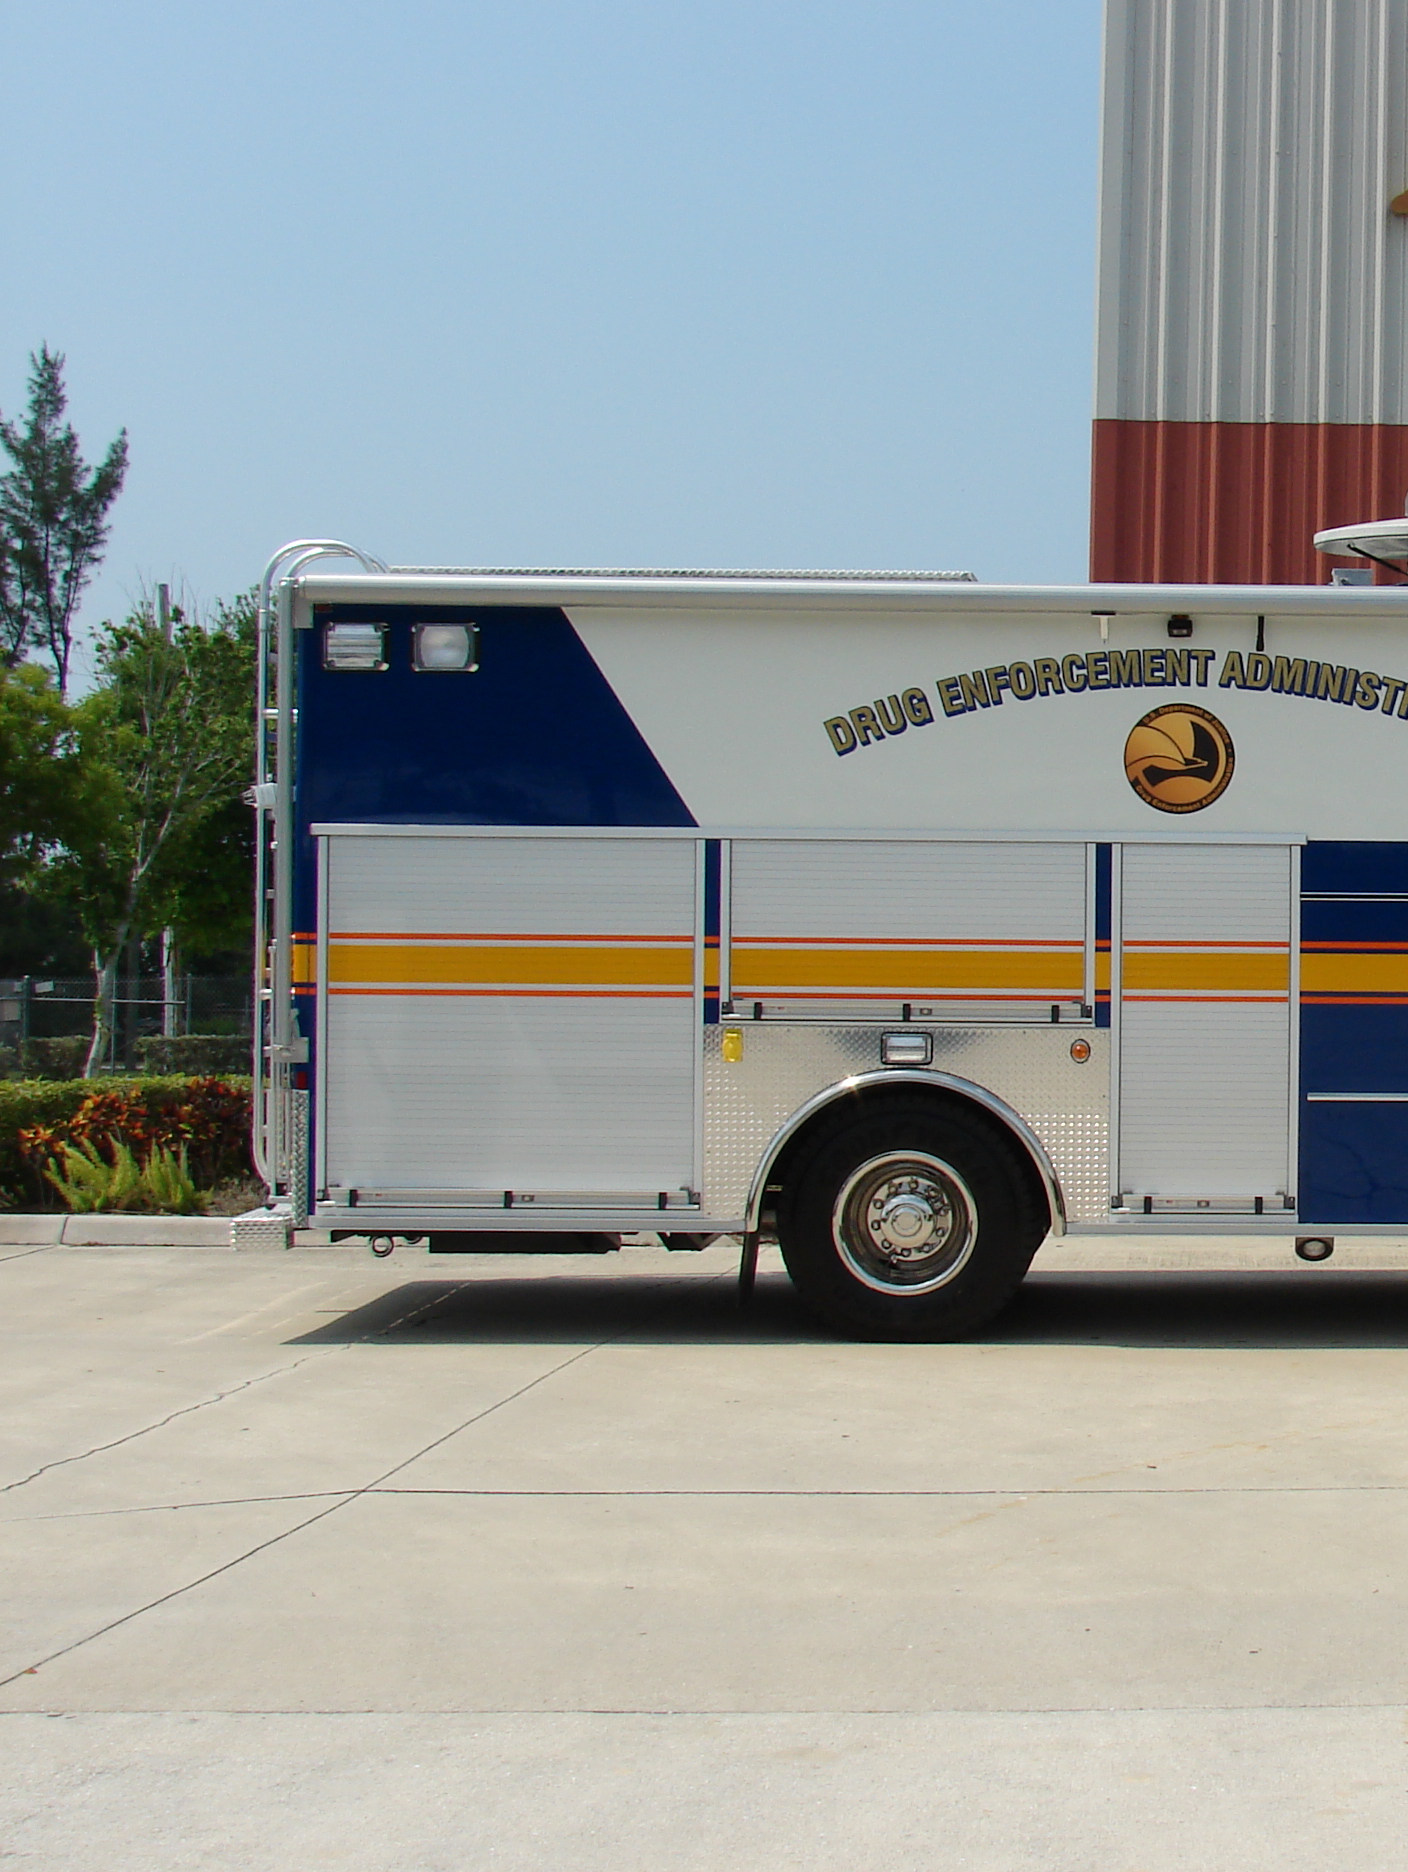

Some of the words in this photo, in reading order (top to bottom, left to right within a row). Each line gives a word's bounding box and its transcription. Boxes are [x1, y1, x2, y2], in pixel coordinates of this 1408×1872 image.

[823, 687, 935, 757] DRUG
[936, 648, 1217, 718] ENFORCEMENT
[1158, 704, 1204, 716] Department
[1203, 711, 1214, 720] of
[1211, 719, 1231, 744] Justice
[1136, 784, 1152, 803] Drug
[1151, 799, 1201, 813] Enforcement
[1201, 756, 1235, 806] Administration
